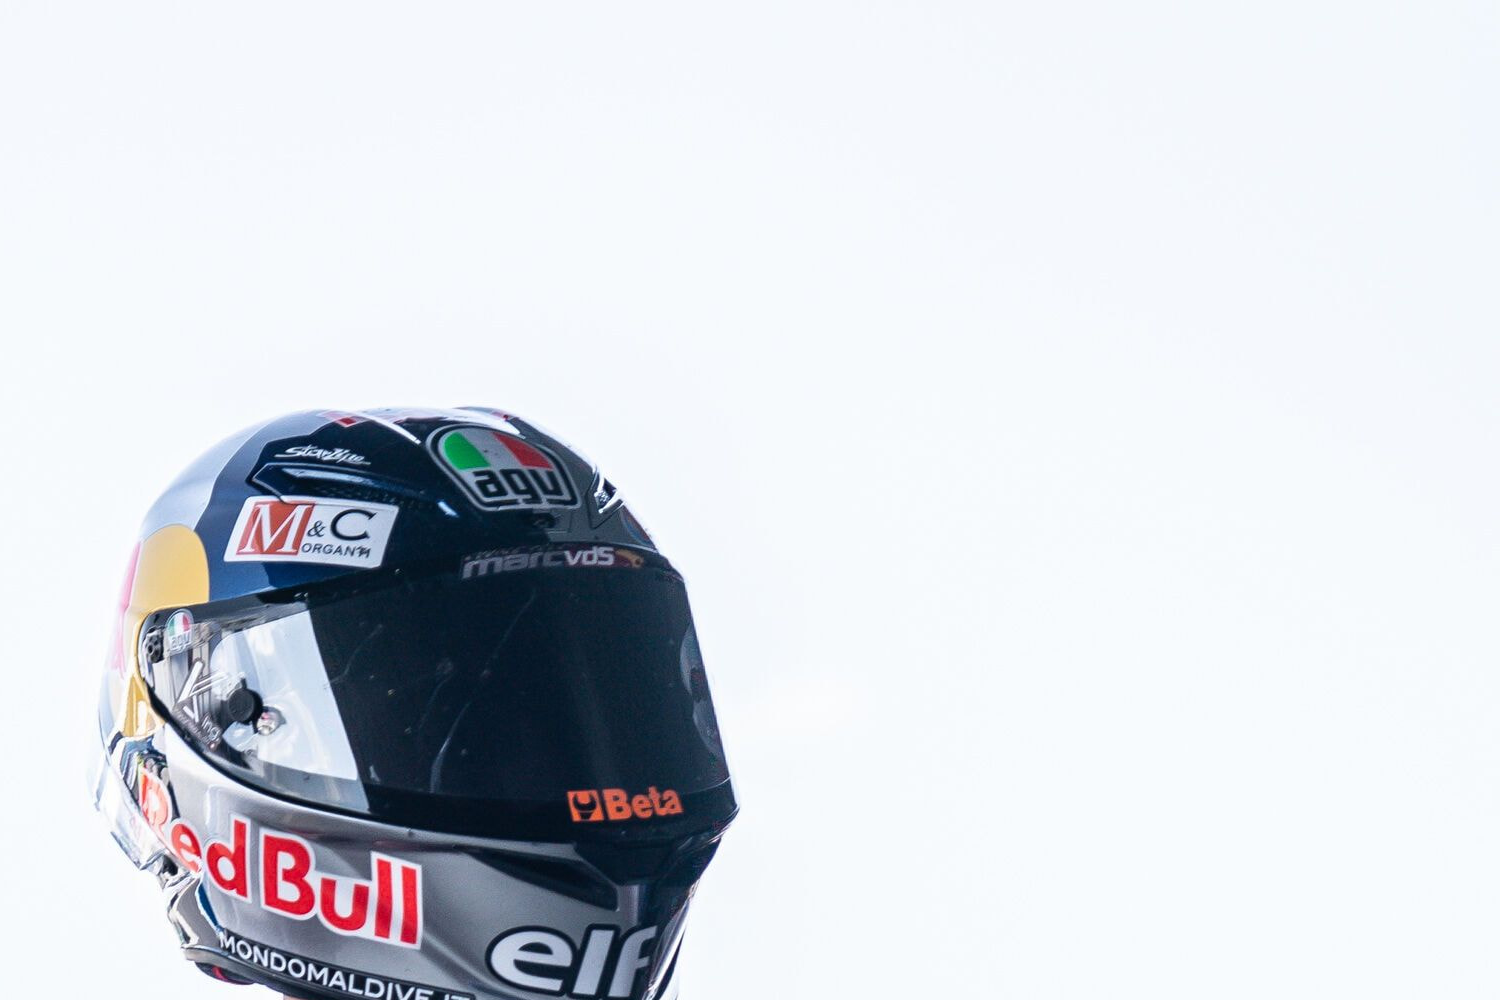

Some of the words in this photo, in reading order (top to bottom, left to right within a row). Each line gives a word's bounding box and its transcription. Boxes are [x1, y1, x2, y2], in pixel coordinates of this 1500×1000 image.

[473, 468, 564, 503] agv
[603, 786, 684, 820] Beta
[264, 835, 418, 945] Bull
[491, 925, 657, 997] elf
